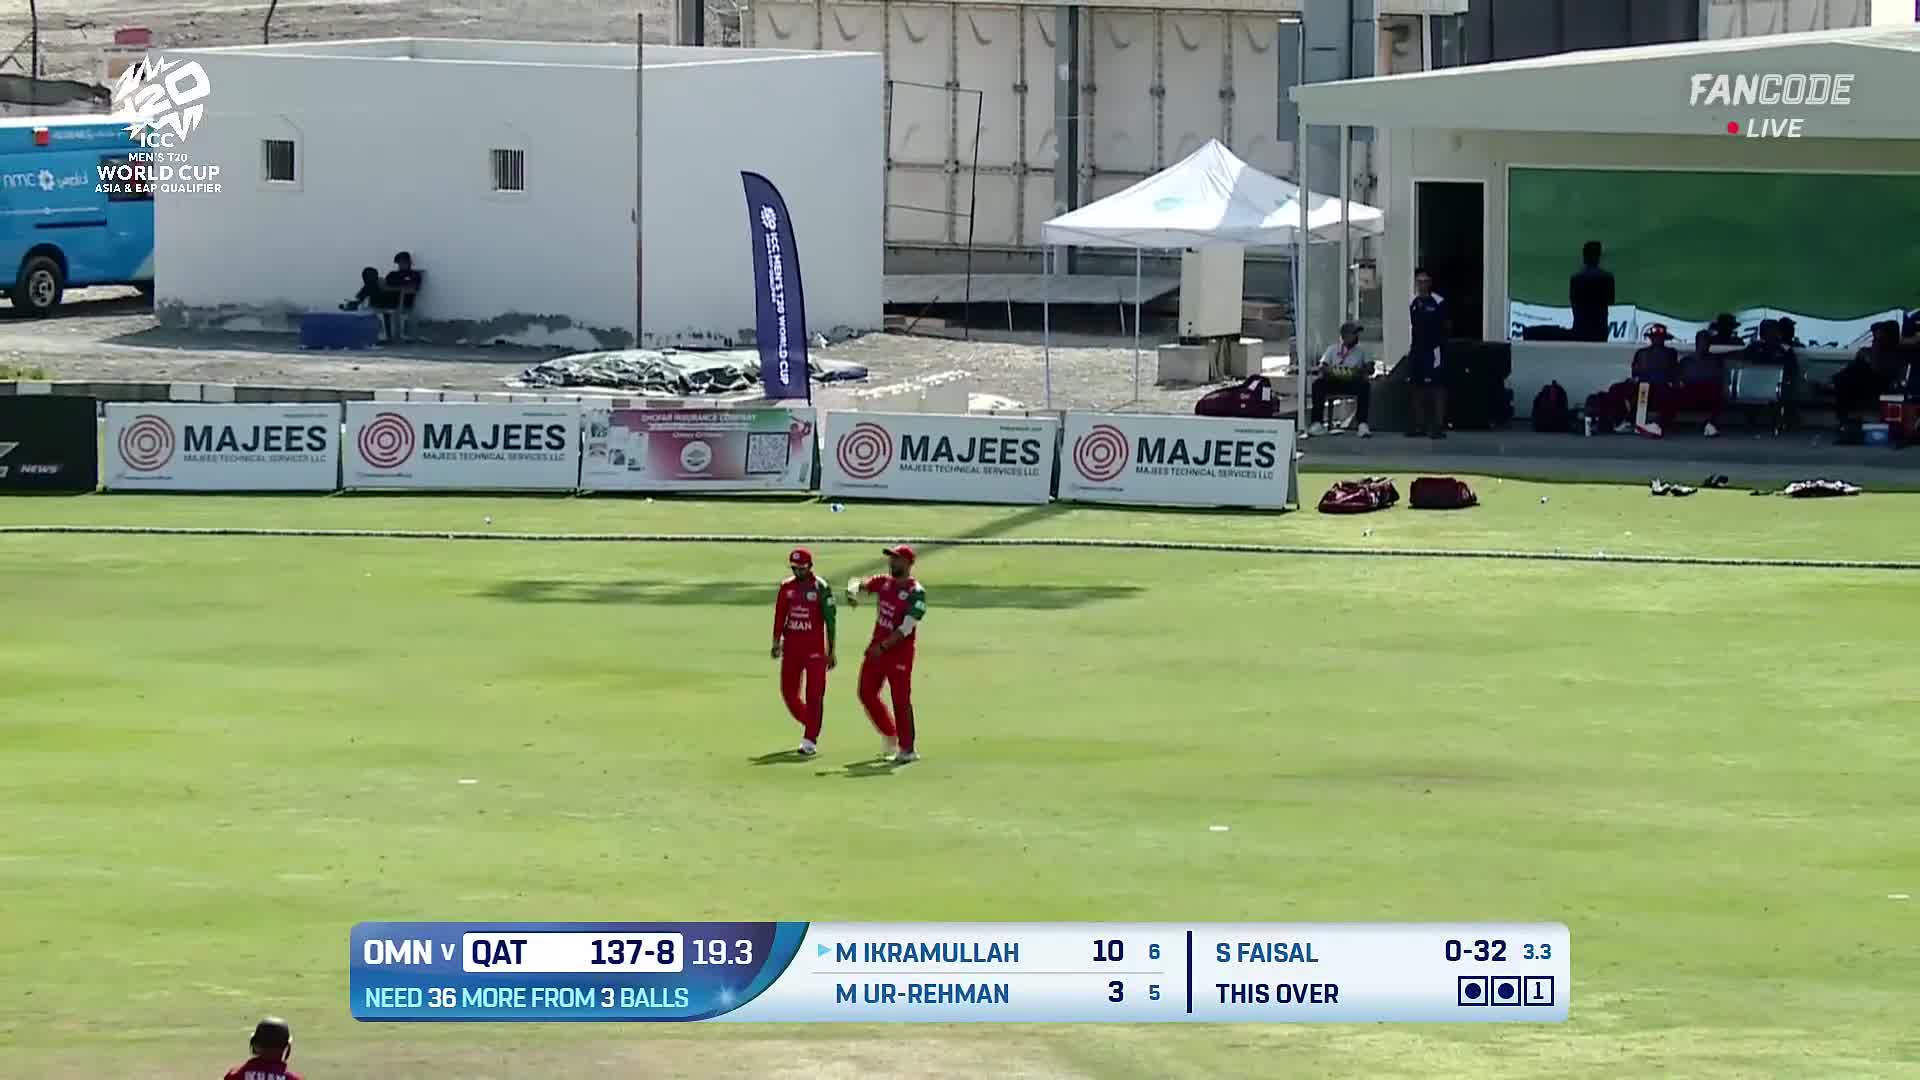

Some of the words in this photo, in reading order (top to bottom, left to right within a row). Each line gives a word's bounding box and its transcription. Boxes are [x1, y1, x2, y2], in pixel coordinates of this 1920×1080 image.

[780, 360, 789, 385] CUP
[184, 425, 328, 452] MAJEES
[423, 423, 567, 450] MAJEES
[900, 435, 1041, 465] MAJEES
[1136, 437, 1276, 468] MAJEES
